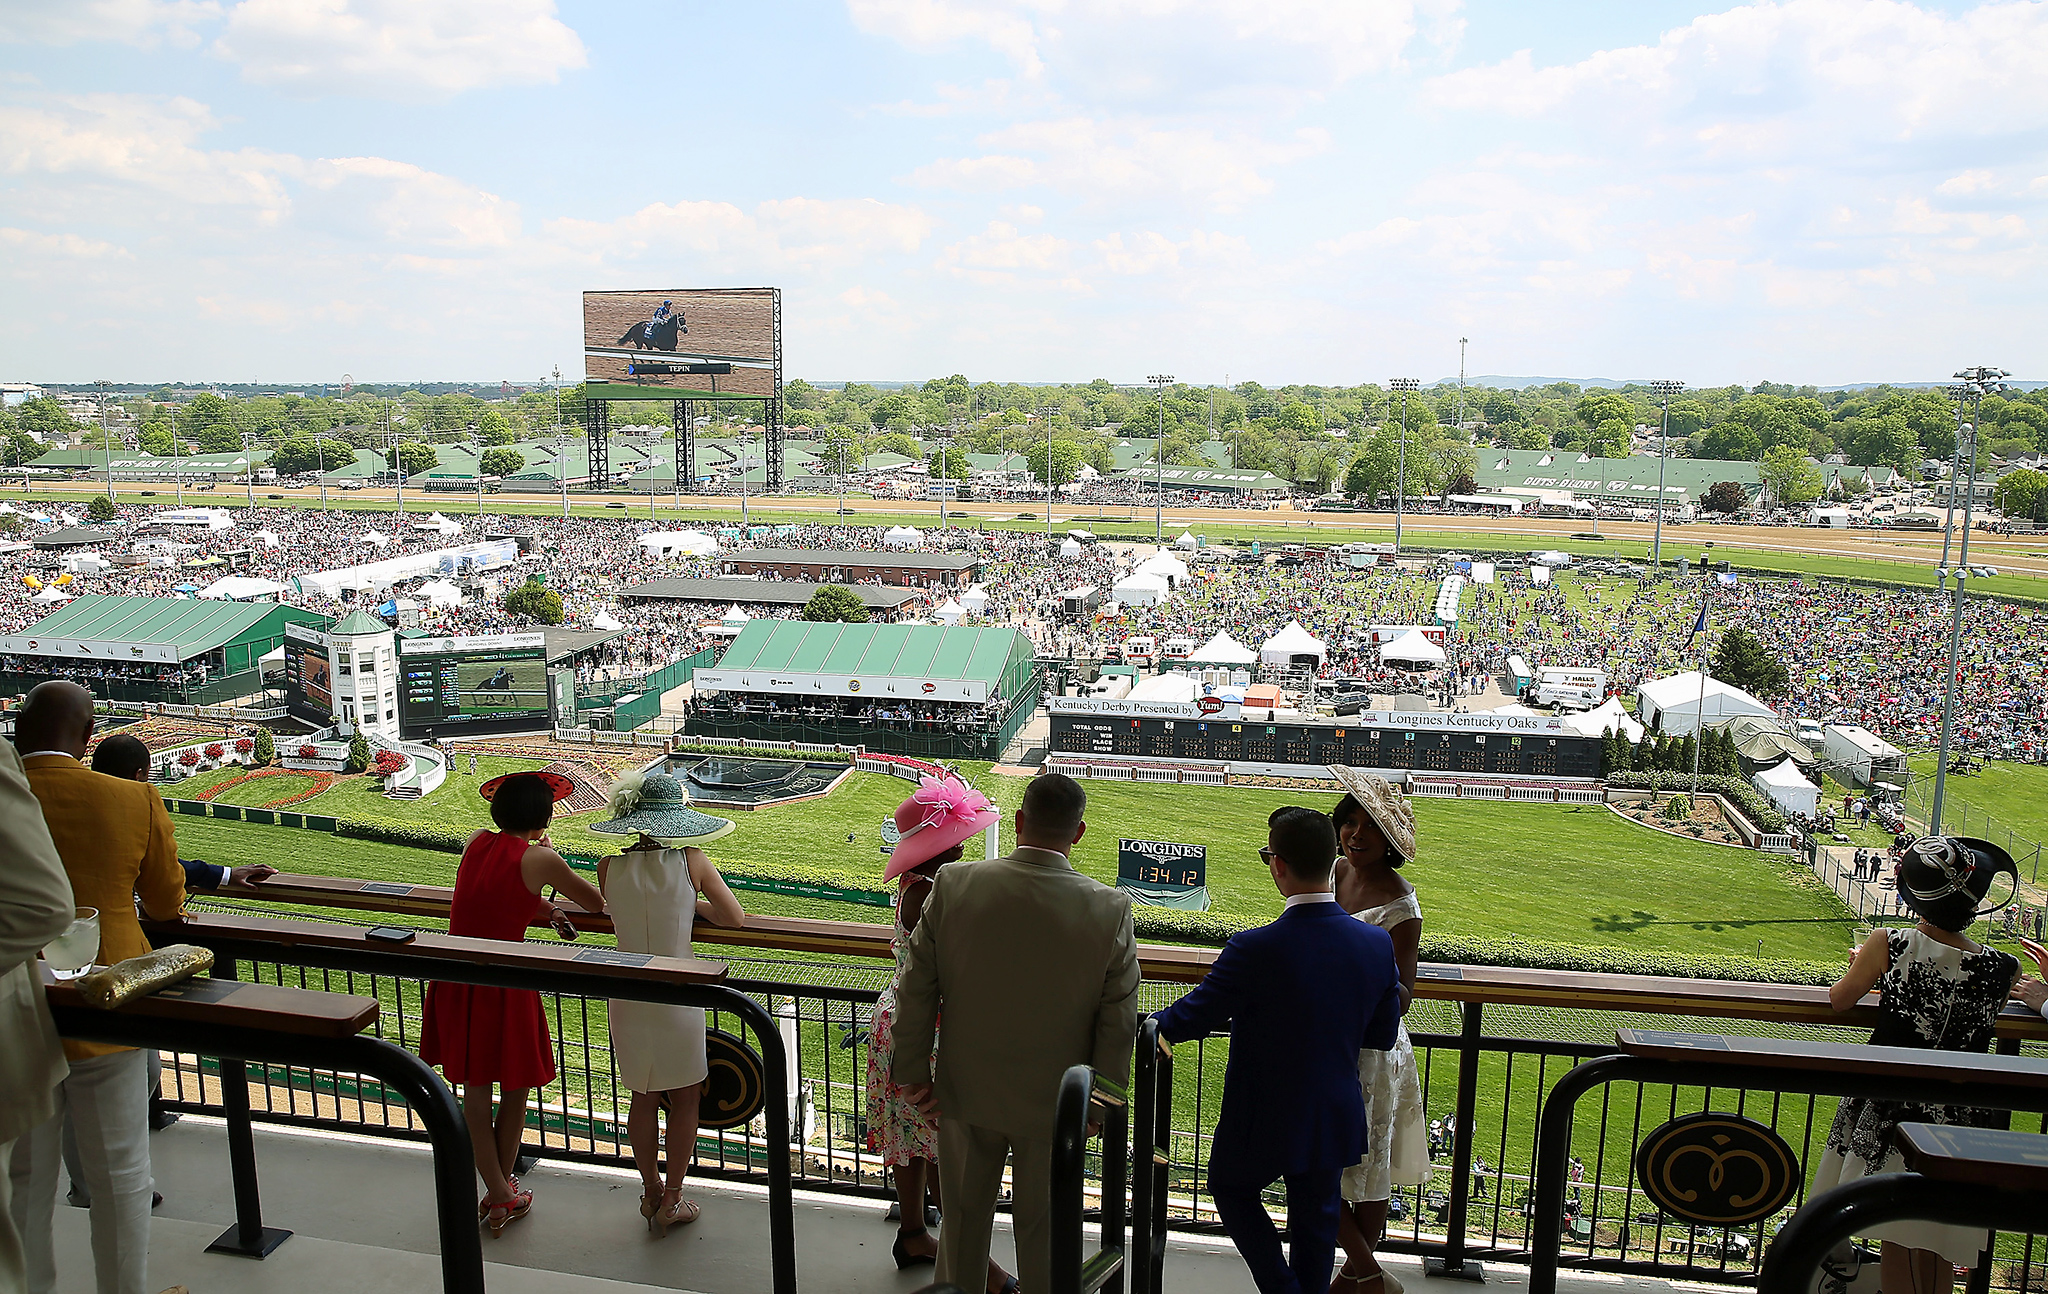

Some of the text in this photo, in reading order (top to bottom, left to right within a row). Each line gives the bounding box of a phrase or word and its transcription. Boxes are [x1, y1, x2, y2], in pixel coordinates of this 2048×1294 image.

[1630, 484, 1688, 493] RAM
[1054, 700, 1194, 716] Kentucky Derby Presented by
[1199, 702, 1223, 710] Yum!
[1388, 713, 1442, 727] Longines
[1447, 715, 1504, 730] Kentucky
[1507, 717, 1538, 729] Oaks
[1120, 840, 1203, 858] LONGINES
[534, 1112, 560, 1120] LOGINES
